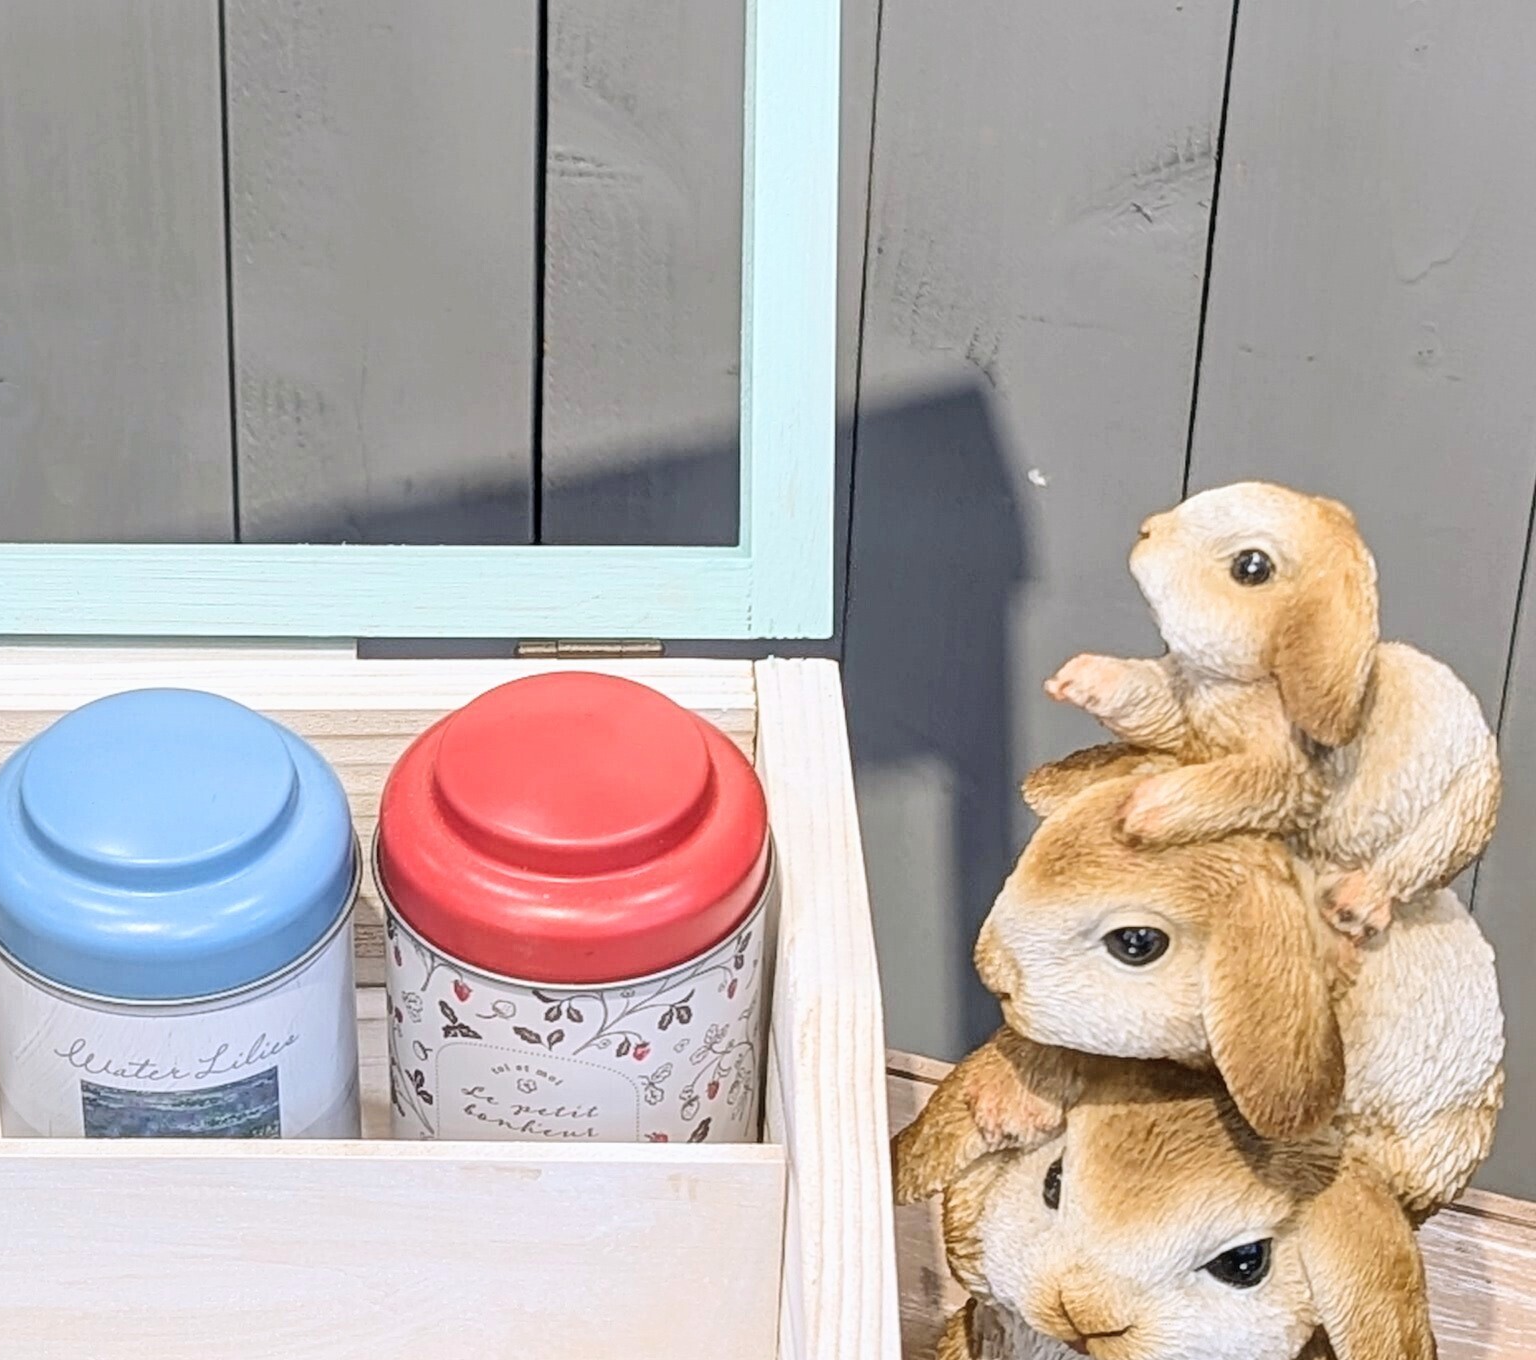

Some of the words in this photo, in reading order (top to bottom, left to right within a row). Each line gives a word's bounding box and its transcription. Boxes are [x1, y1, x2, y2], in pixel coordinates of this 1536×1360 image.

[54, 1038, 191, 1081] Water
[194, 1032, 300, 1080] Lilies
[510, 1104, 600, 1119] petit
